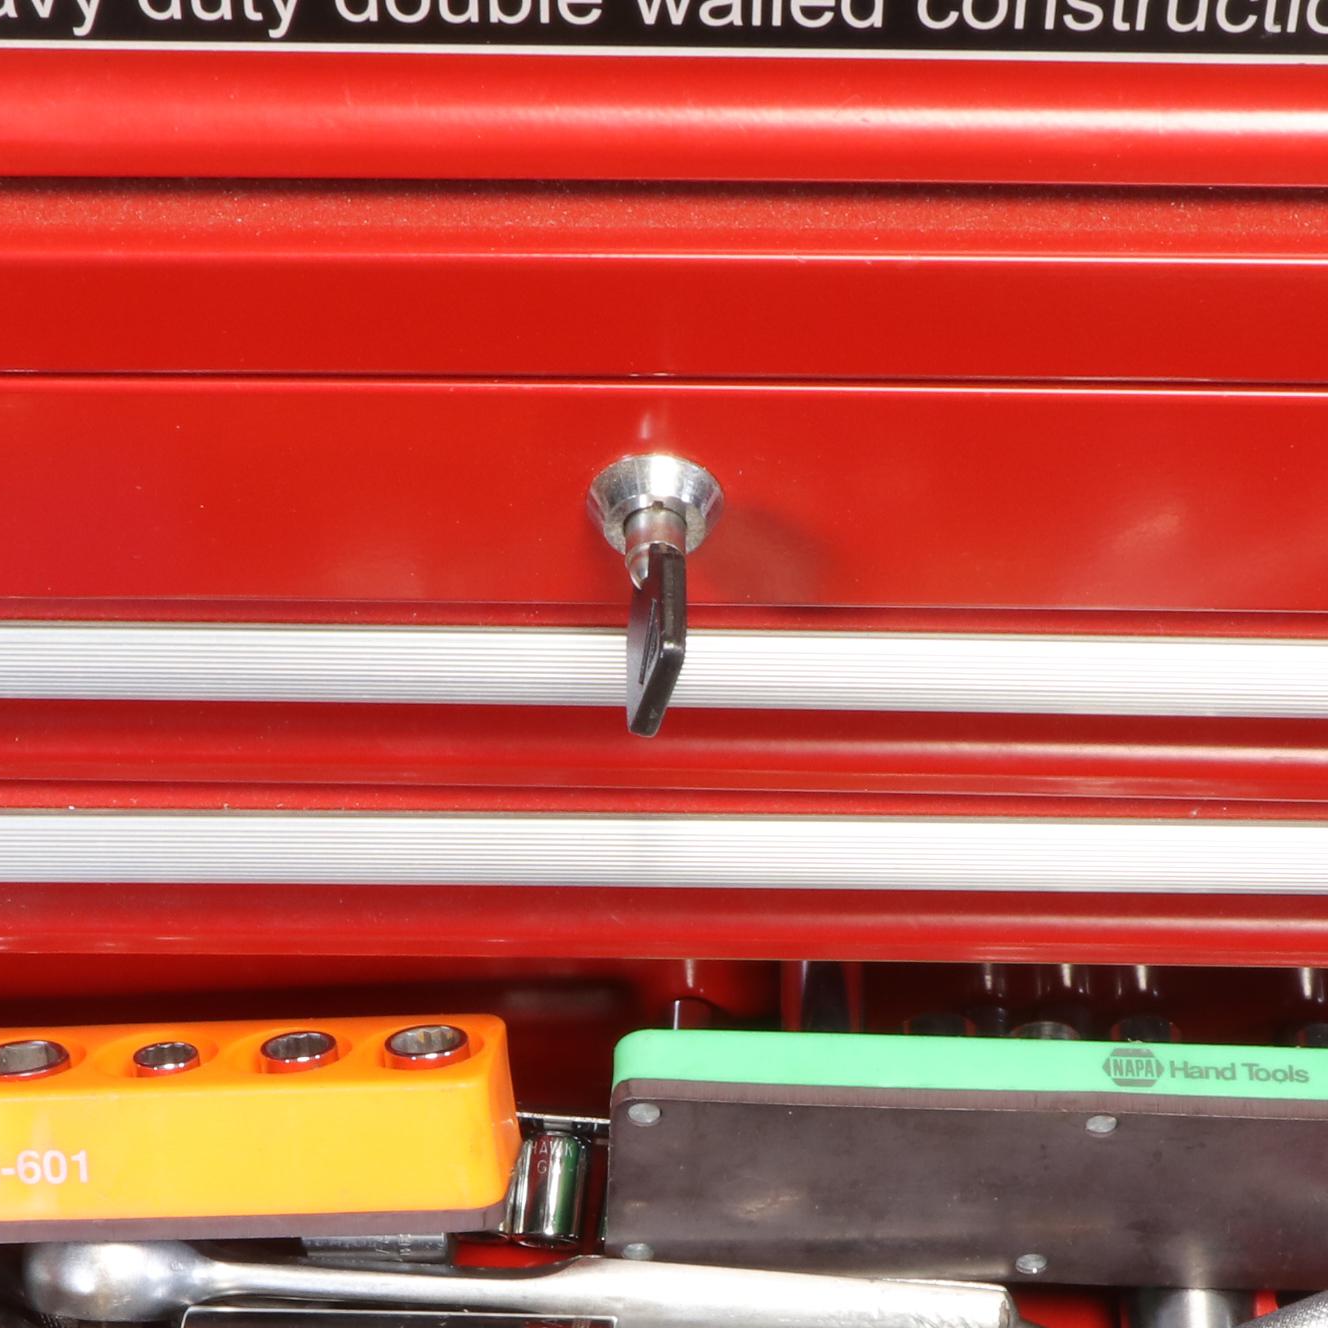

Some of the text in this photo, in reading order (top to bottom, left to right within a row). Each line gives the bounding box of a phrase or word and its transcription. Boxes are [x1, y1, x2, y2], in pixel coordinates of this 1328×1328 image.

[1111, 1056, 1156, 1080] NAPA
[1169, 1060, 1237, 1082] Hand
[1241, 1062, 1311, 1085] Tools
